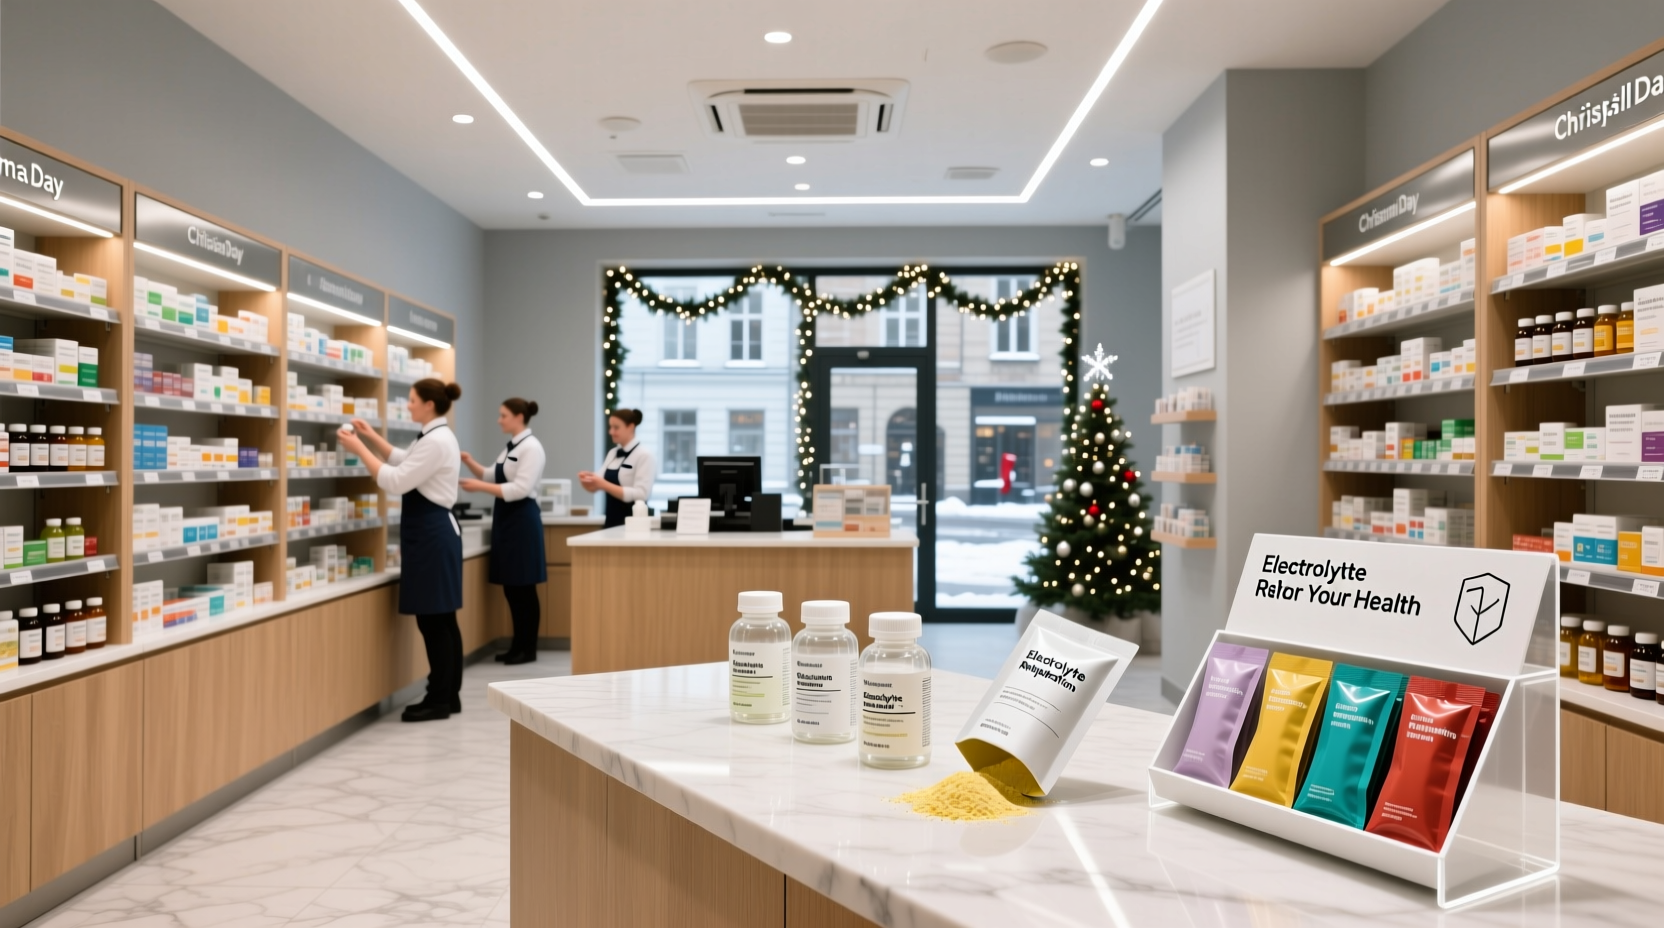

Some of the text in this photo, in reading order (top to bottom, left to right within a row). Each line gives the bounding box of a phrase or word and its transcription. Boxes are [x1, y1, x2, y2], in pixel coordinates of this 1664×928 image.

[31, 163, 64, 200] Day
[1262, 554, 1367, 585] Electrolytte
[1308, 584, 1352, 606] Your
[1353, 589, 1421, 616] Health
